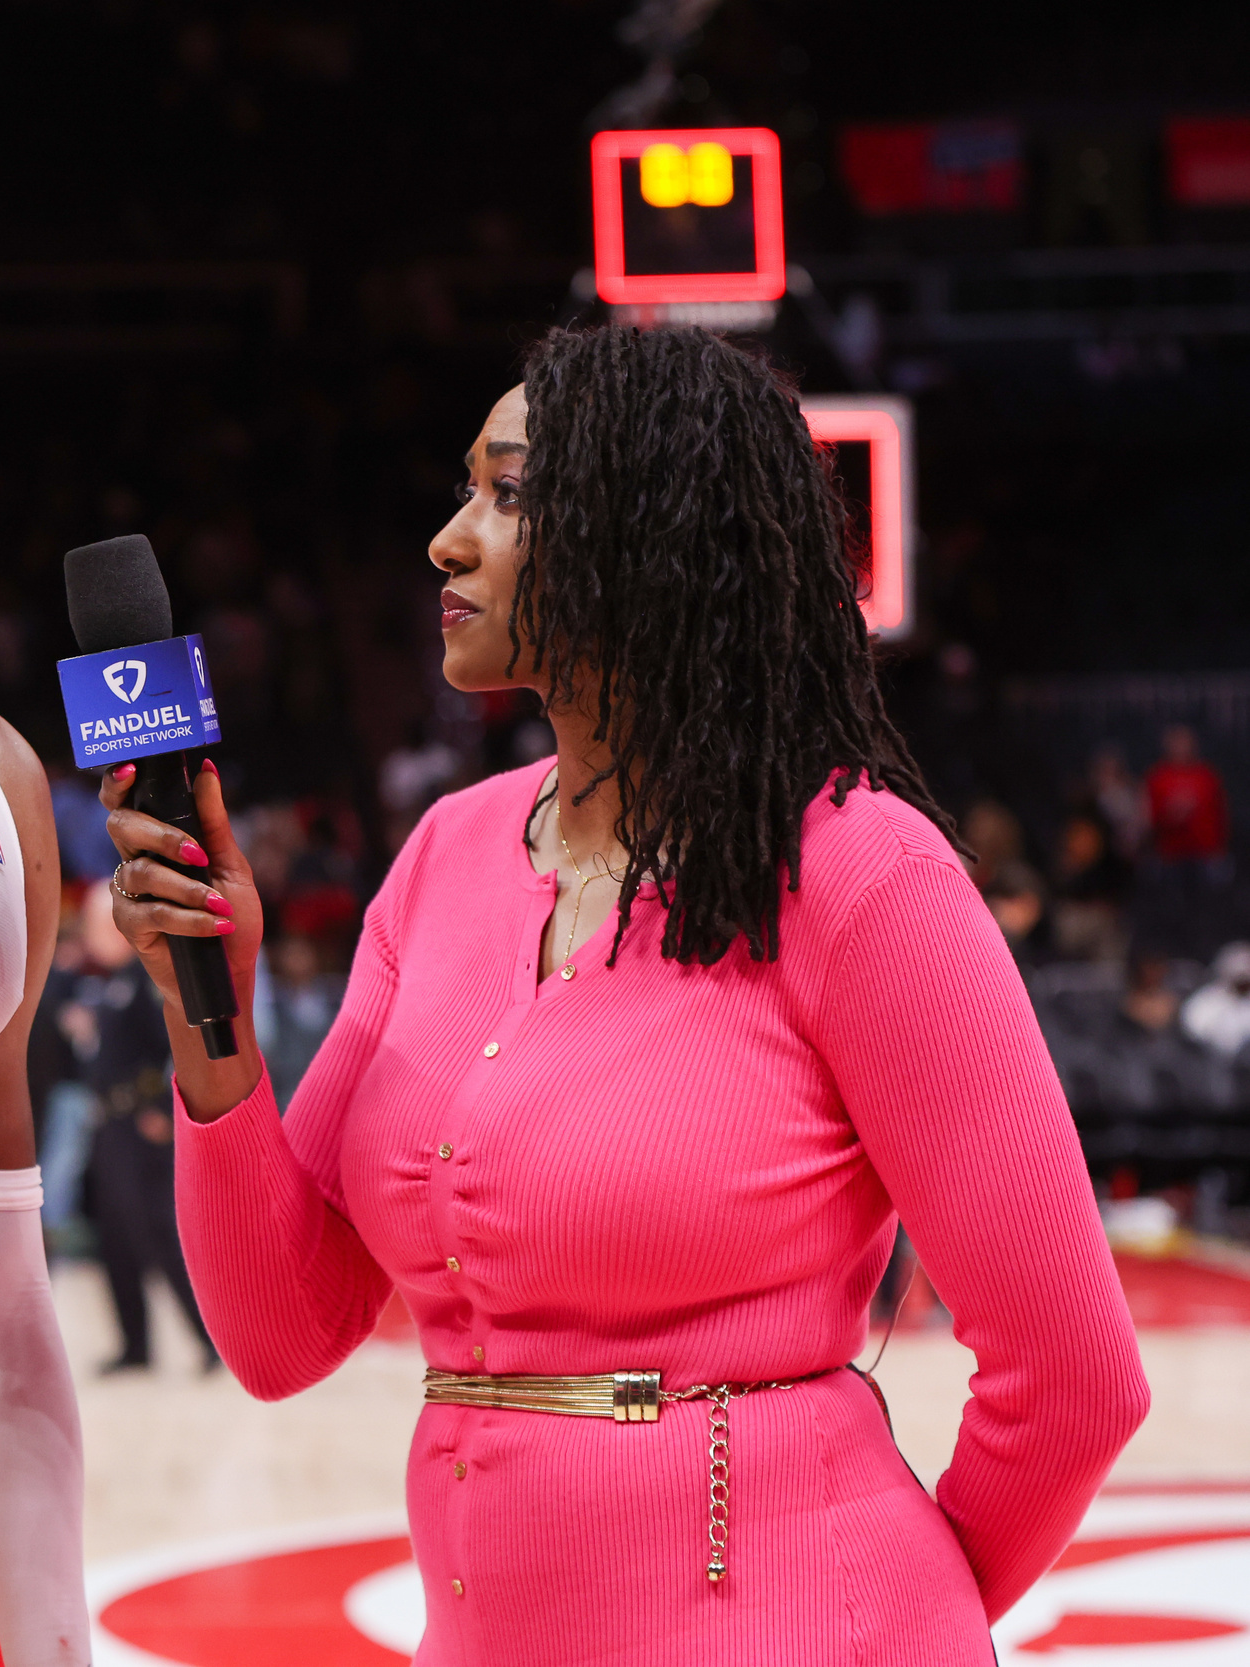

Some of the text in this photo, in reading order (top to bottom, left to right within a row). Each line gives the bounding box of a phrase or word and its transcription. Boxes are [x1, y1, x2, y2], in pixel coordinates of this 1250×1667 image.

[80, 704, 191, 741] FANDUEL
[84, 737, 132, 756] SPORTS
[133, 725, 193, 746] NETWORK
